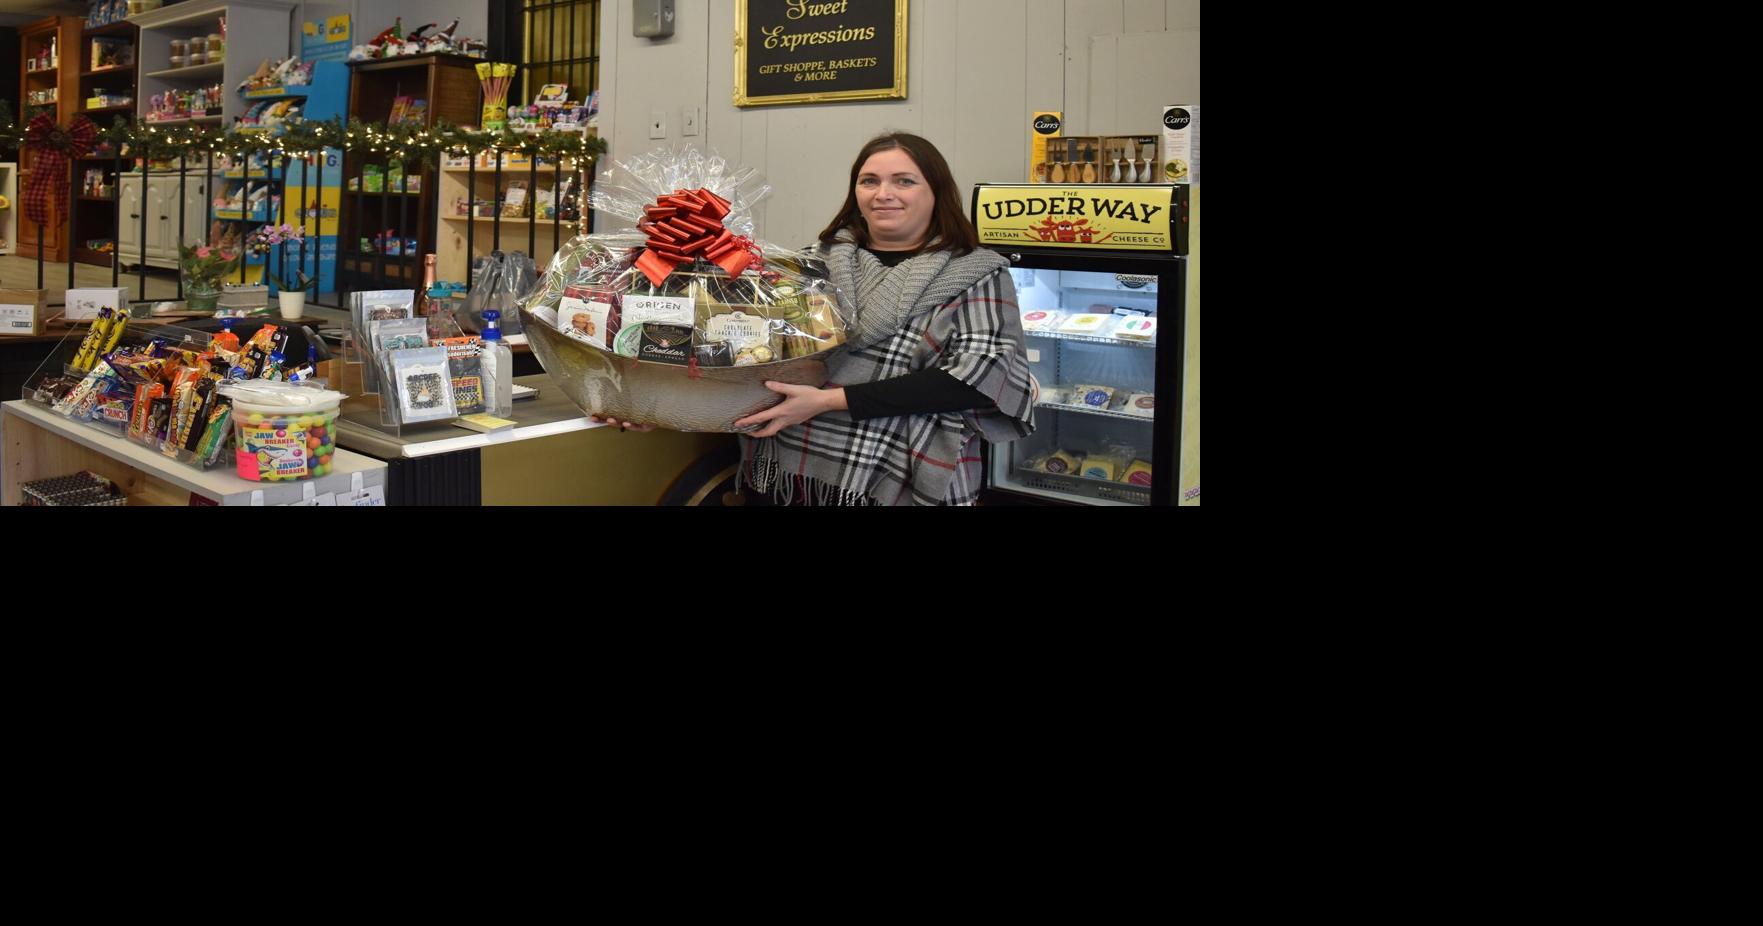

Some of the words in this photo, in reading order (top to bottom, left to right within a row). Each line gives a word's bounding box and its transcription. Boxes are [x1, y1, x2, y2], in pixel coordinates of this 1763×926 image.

[786, 0, 848, 20] Sweet
[761, 25, 876, 52] Expressions
[759, 64, 783, 75] GIFT
[783, 61, 826, 74] SHOPPE,
[829, 57, 877, 69] BASKETS
[794, 73, 803, 82] &
[804, 70, 837, 81] MORE
[982, 197, 1085, 220] UDDER
[1091, 198, 1162, 224] WAY
[1112, 235, 1149, 243] CHEESE
[643, 344, 686, 357] Cheddar
[104, 407, 128, 420] CRUNCH
